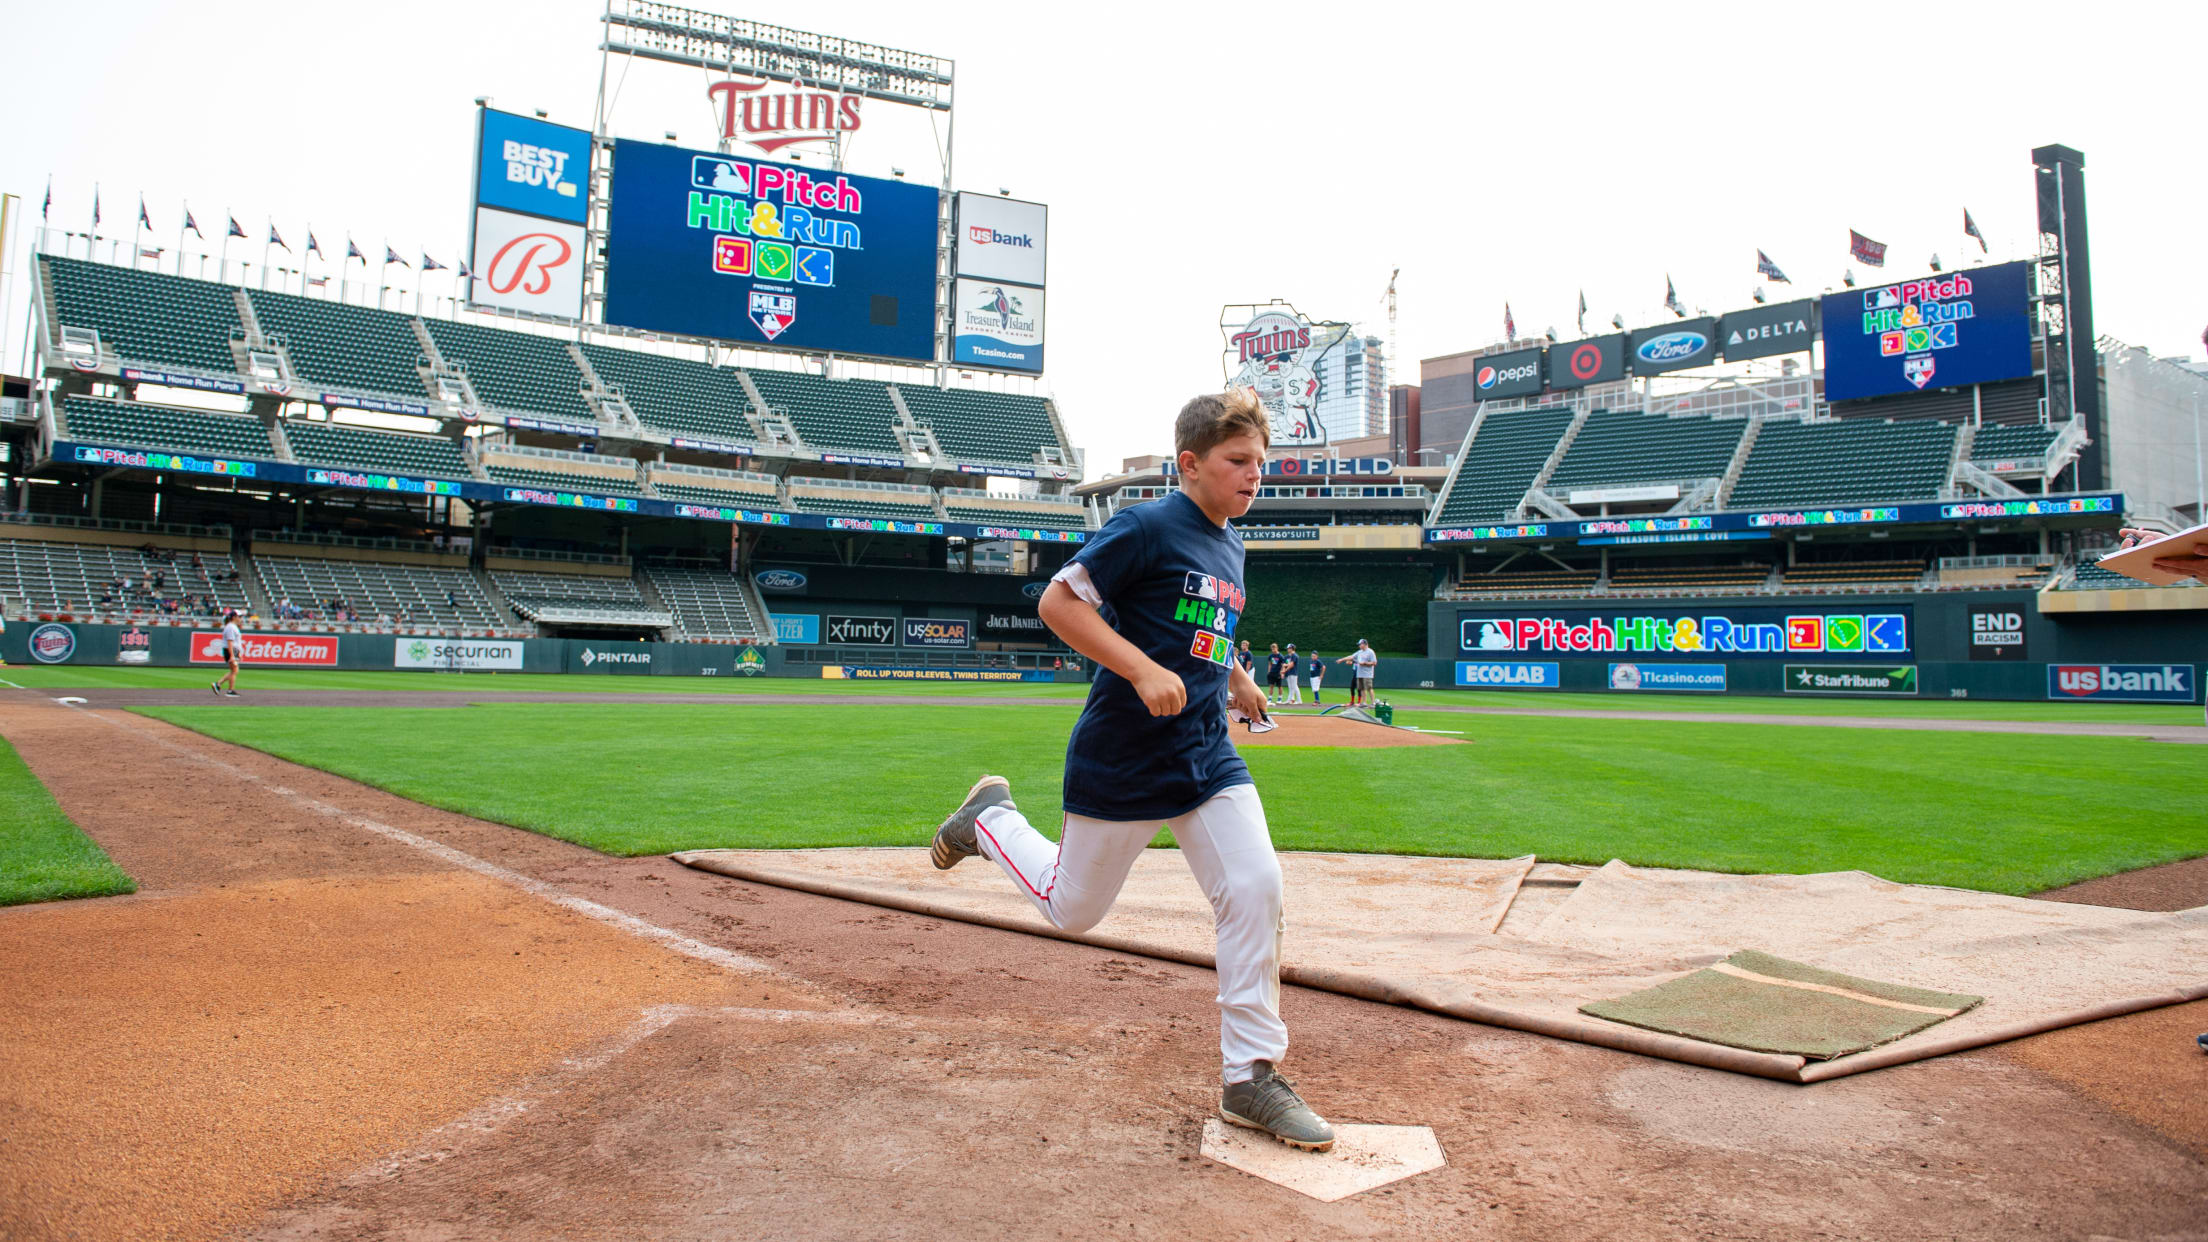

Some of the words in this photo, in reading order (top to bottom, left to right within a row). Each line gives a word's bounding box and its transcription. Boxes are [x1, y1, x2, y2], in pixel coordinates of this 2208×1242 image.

[708, 76, 862, 140] Twins
[503, 139, 570, 172] BEST
[506, 161, 563, 190] BUY
[755, 164, 862, 214] Pitch
[687, 191, 861, 250] Hit&Run
[488, 233, 572, 295] B
[1901, 273, 1973, 305] Pitch
[752, 294, 793, 312] MLB
[965, 310, 1001, 328] Treasure
[1009, 315, 1034, 332] Island
[1864, 300, 1975, 335] Hit&Run
[1747, 319, 1807, 341] DELTA
[1231, 325, 1311, 364] Twins
[1651, 335, 1693, 359] Ford
[1498, 361, 1538, 384] pepsi
[167, 375, 193, 385] Home
[195, 378, 212, 387] Run
[214, 380, 239, 391] Porch
[402, 404, 424, 414] Porch
[1308, 458, 1394, 475] FIELD
[1615, 535, 1659, 544] TREASURE
[1665, 533, 1699, 542] ISLAND
[1705, 532, 1729, 541] COVE
[765, 571, 797, 588] Ford
[1219, 579, 1246, 614] Pit
[986, 614, 1009, 628] JACK
[1174, 598, 1237, 640] Hit&R
[1972, 613, 2023, 631] END
[121, 633, 149, 646] 1991
[830, 619, 893, 643] xfinity
[1976, 634, 2020, 643] RACISM
[34, 637, 69, 650] Twins
[924, 636, 965, 645] us-solar.com
[434, 644, 512, 660] securian
[598, 652, 651, 664] PENTAIR
[702, 667, 717, 676] 377
[735, 662, 764, 670] SUMMIT
[856, 669, 878, 678] ROLL
[879, 670, 890, 678] UP
[892, 670, 914, 678] YOUR
[915, 670, 953, 680] SLEEVES,
[953, 671, 978, 679] TWINS
[979, 672, 1022, 680] TERRITORY
[1466, 664, 1545, 683] ECOLAB
[1420, 680, 1434, 688] 403
